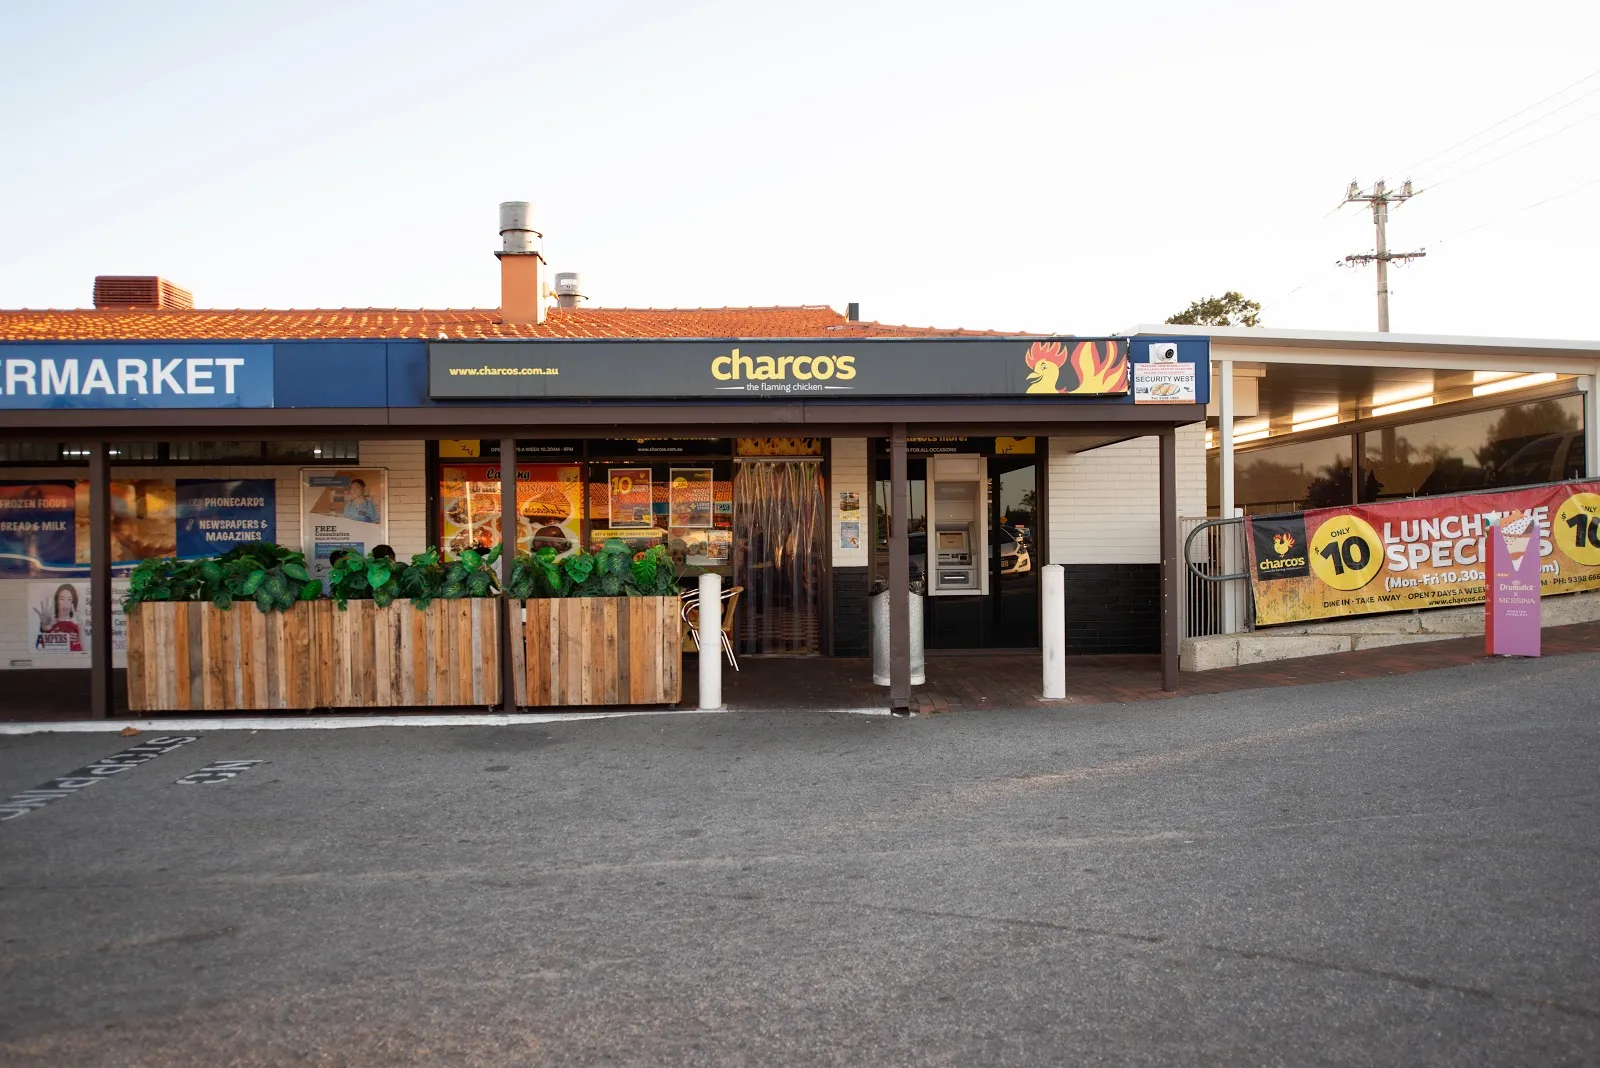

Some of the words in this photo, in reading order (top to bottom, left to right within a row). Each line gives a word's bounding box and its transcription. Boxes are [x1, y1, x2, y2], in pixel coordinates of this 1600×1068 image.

[711, 348, 857, 380] charco's
[449, 366, 559, 375] www.charcos.com.au
[0, 358, 245, 395] RMARKET
[746, 383, 759, 391] the
[761, 383, 791, 392] flaming
[792, 383, 823, 391] chicken
[204, 497, 265, 507] PHONECARDS
[1, 522, 31, 531] BREAD
[42, 522, 66, 531] MILK
[199, 520, 259, 529] NEWSPAPERS
[260, 520, 268, 529] &
[205, 531, 262, 541] MAGAZINES
[1330, 527, 1351, 538] ONLY
[1386, 529, 1554, 572] SPECIS
[1385, 573, 1440, 592] (Mon-Fri
[1442, 571, 1486, 585] 10.30a
[1499, 583, 1536, 591] Drumstick
[1323, 600, 1341, 608] DINE
[1356, 597, 1375, 605] TAKE
[1377, 595, 1401, 603] AWAY
[1407, 592, 1430, 600] OPEN
[1437, 589, 1457, 597] DAYS
[1428, 596, 1486, 606] www.charcos.co
